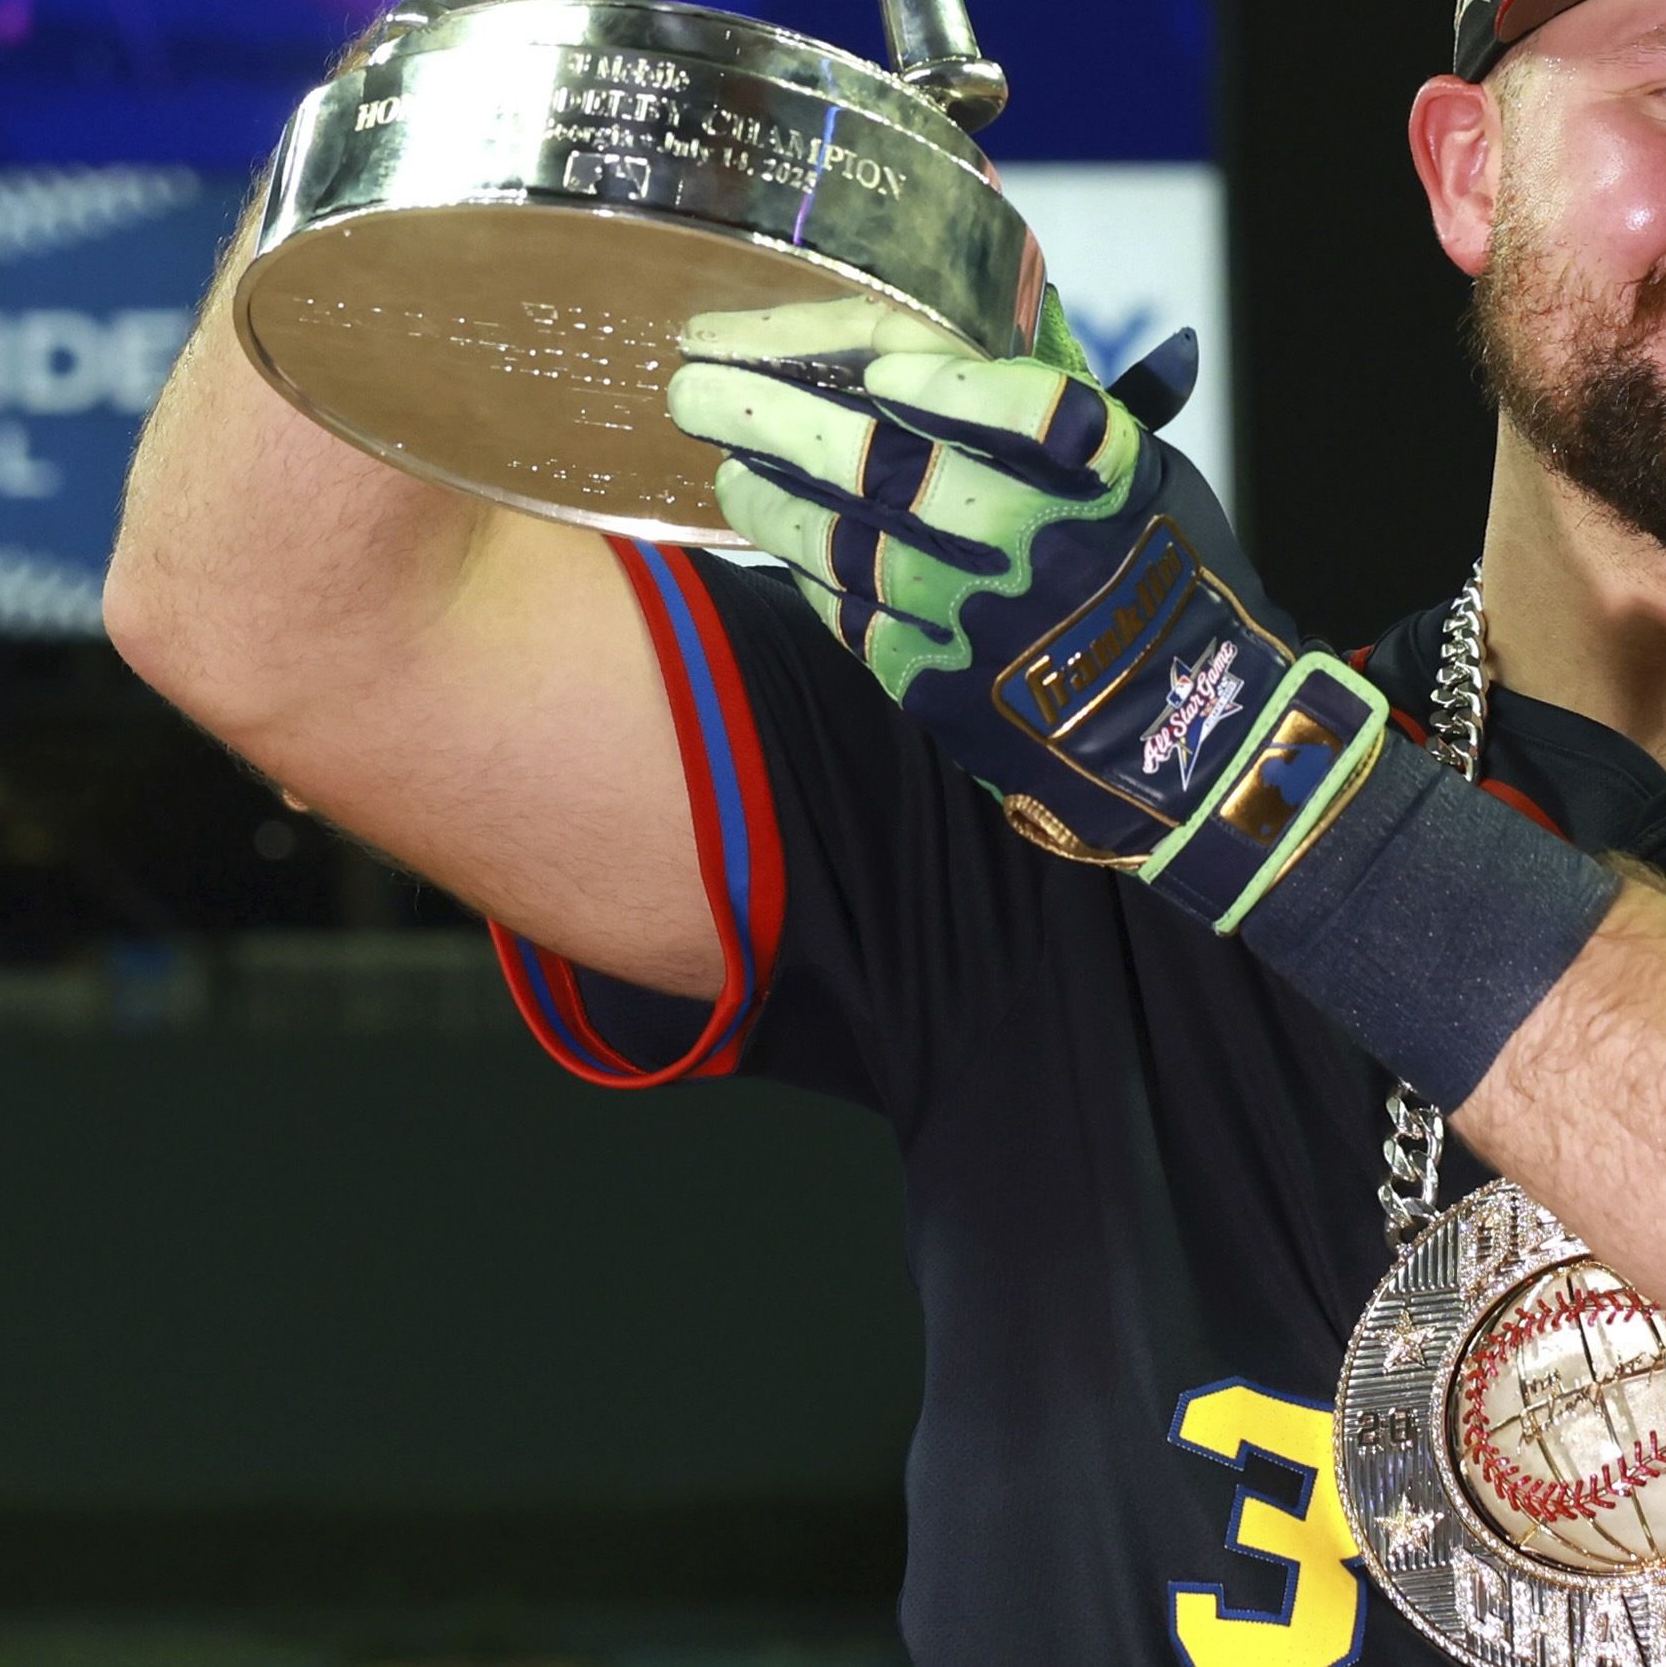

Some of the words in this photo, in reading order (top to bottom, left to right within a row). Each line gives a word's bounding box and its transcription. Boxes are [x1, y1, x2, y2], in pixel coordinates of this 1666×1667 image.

[701, 106, 907, 202] CHAMPION
[1025, 541, 1182, 725] Franklin
[1142, 727, 1175, 774] All
[1170, 694, 1206, 737] Star
[1195, 640, 1237, 700] Game
